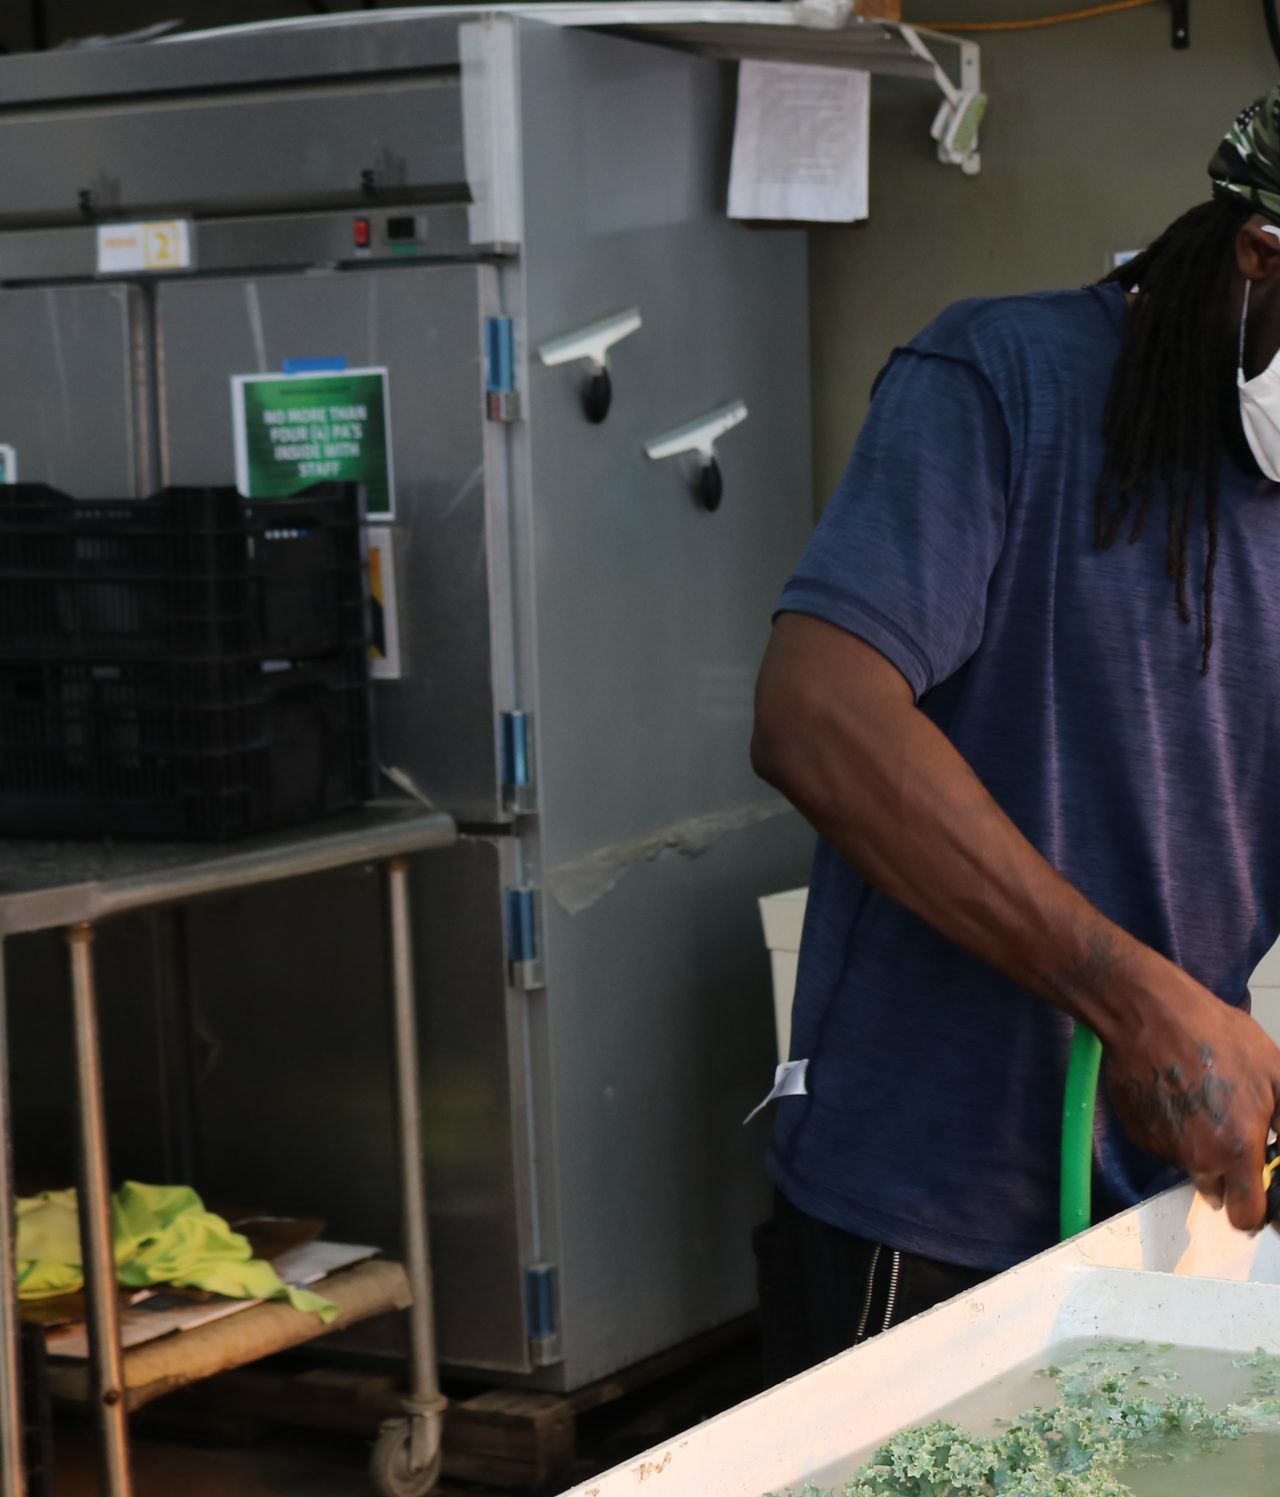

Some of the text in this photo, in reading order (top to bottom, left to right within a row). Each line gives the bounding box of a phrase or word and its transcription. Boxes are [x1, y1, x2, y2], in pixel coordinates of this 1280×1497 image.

[263, 405, 367, 425] NO MORE THAN
[270, 426, 308, 443] FOUR
[274, 442, 360, 461] INSIDE WITH
[298, 460, 341, 478] STAFF
